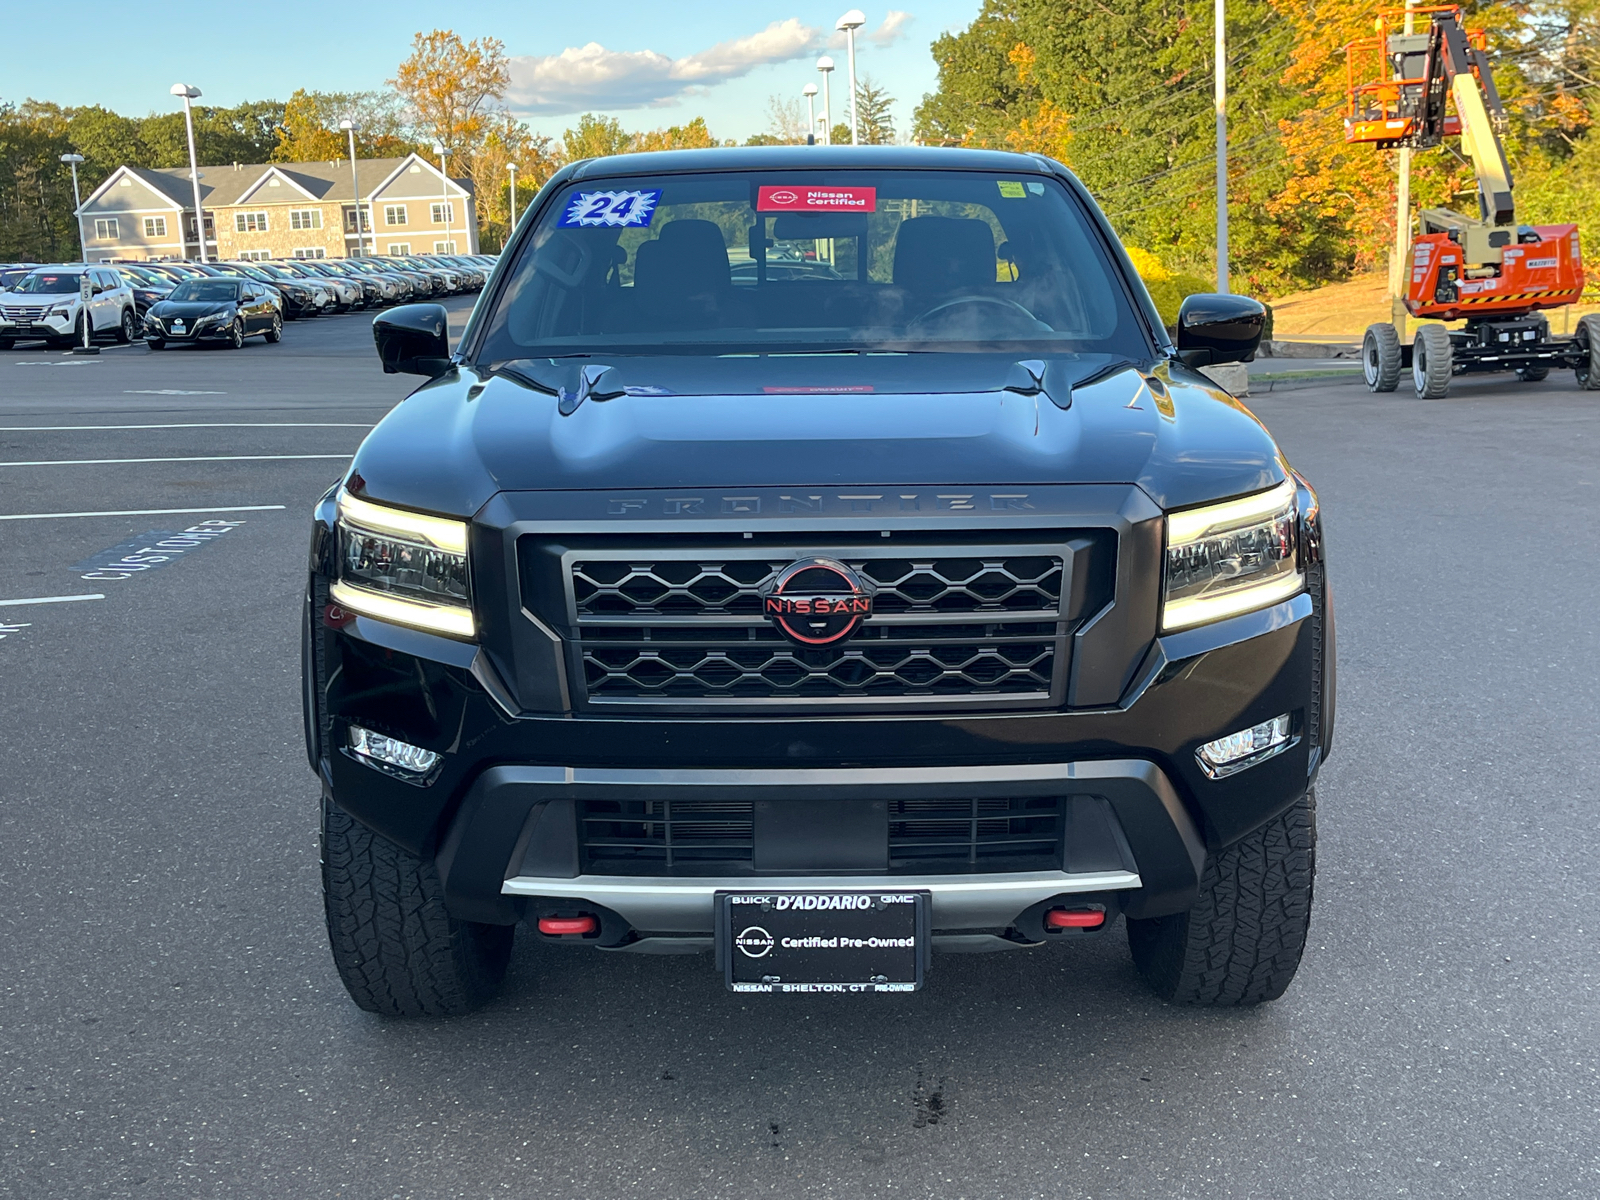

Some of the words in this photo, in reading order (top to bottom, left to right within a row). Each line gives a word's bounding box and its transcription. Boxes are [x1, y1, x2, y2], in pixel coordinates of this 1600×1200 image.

[583, 196, 637, 218] 24
[84, 290, 89, 299] 5
[607, 494, 1035, 514] FRONTIER
[81, 520, 246, 580] CUSTOMER
[766, 599, 869, 613] NISSAN
[732, 896, 770, 904] BUICK
[776, 895, 871, 910] D'ADDARIO
[880, 895, 914, 903] GMC
[736, 938, 774, 946] NISSAN
[781, 936, 837, 948] Certified
[840, 936, 914, 948] Pre-Owned
[733, 984, 772, 992] NISSAN
[782, 983, 846, 993] SHELTON,
[849, 983, 867, 992] CT
[875, 984, 915, 992] PRE-OWNED
